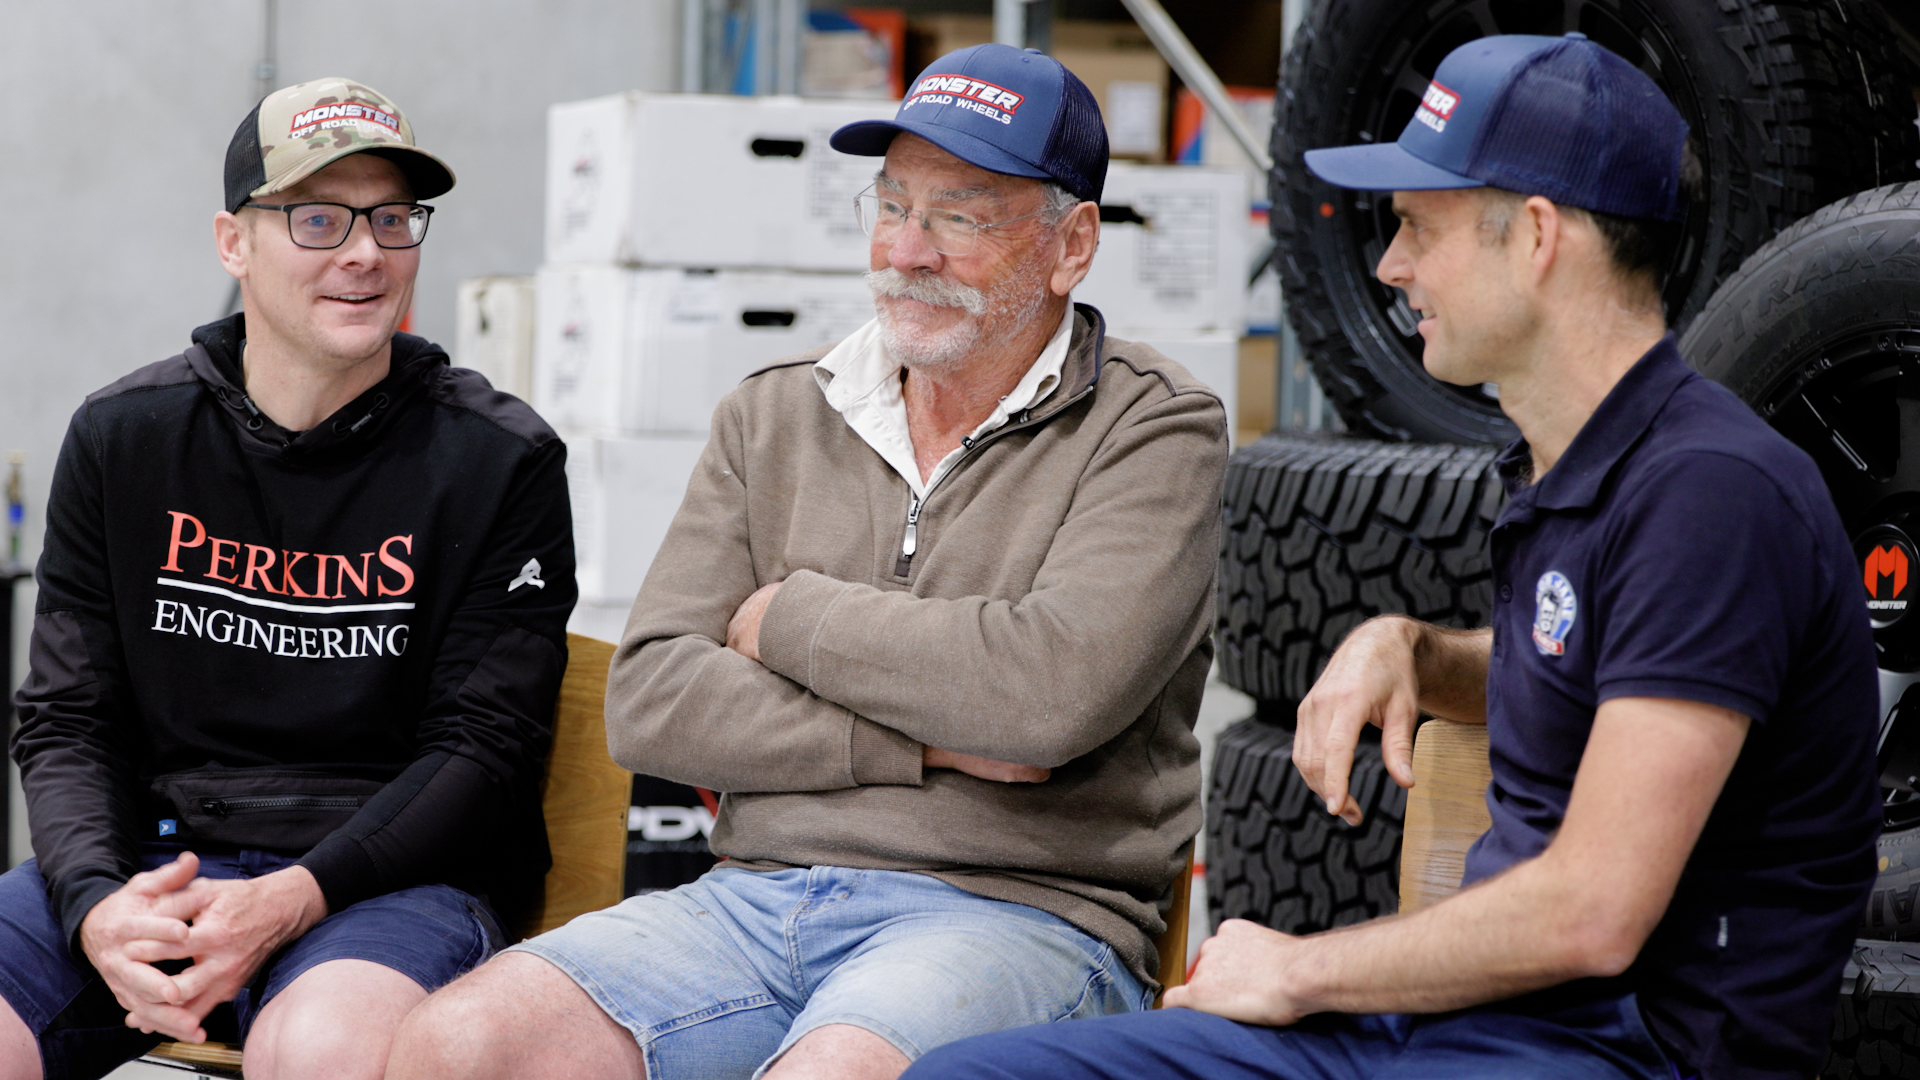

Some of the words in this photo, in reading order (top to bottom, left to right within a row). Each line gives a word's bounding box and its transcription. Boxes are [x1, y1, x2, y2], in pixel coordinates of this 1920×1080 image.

[911, 76, 1020, 111] MONSTER
[919, 94, 953, 105] ROAD
[955, 98, 1012, 125] WHEELS
[291, 125, 317, 139] OFF
[321, 120, 359, 130] ROAD
[293, 104, 398, 130] MONSTER
[160, 510, 415, 599] PERKINS
[151, 599, 409, 658] ENGINEERING
